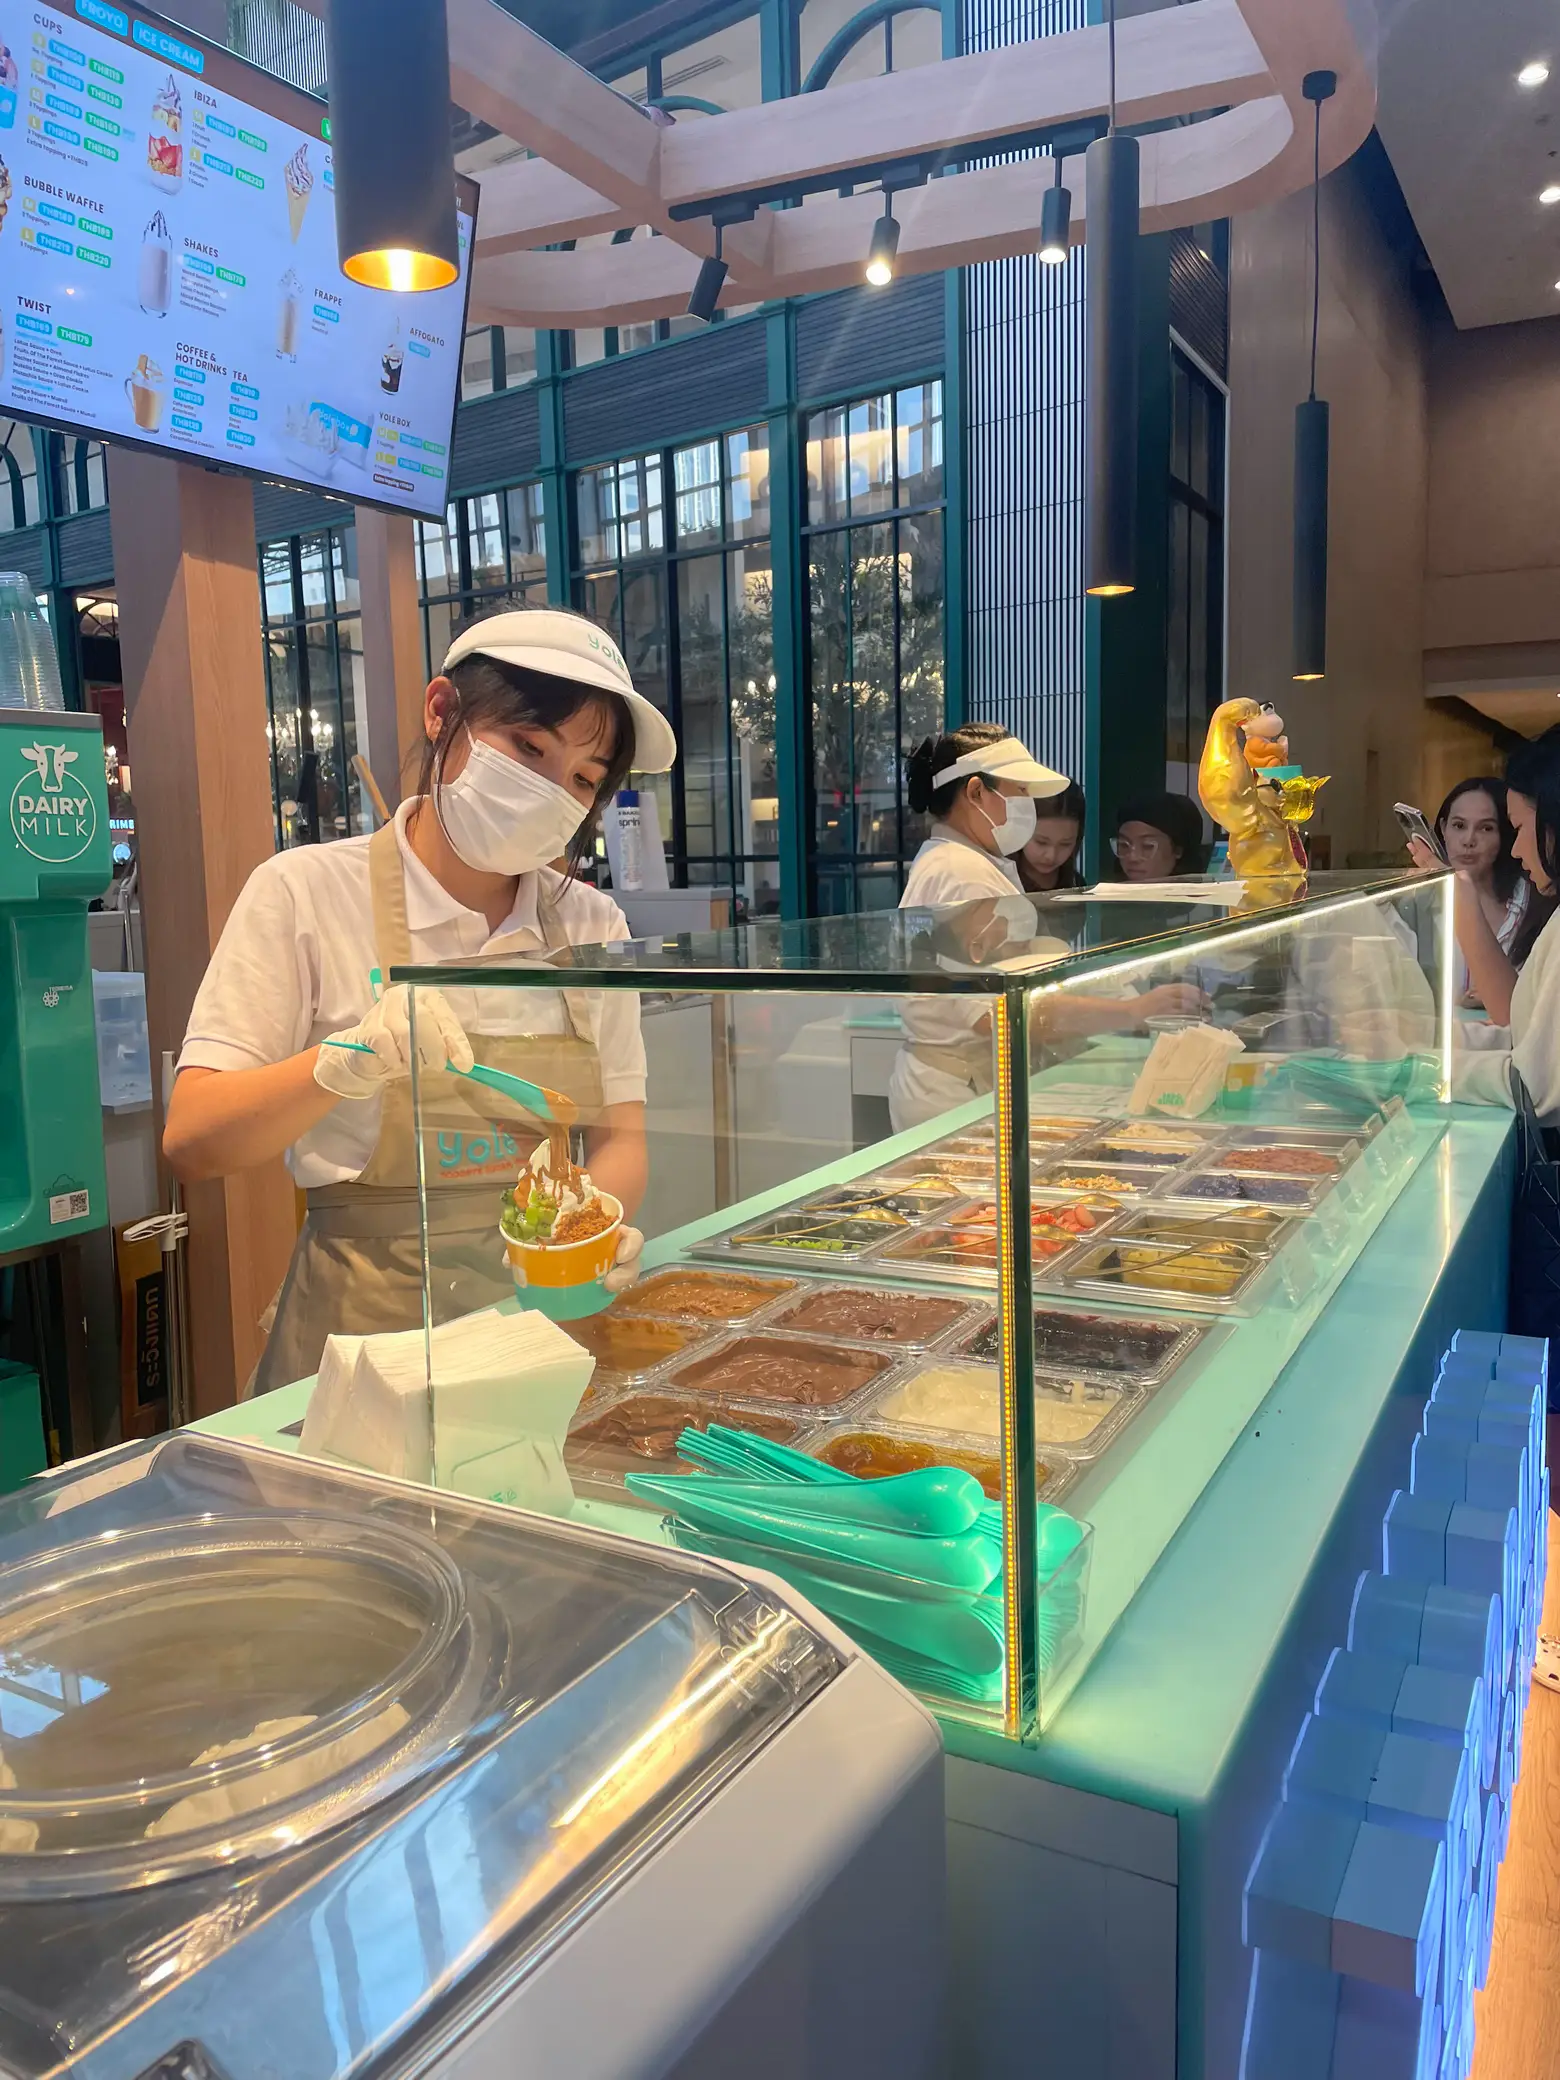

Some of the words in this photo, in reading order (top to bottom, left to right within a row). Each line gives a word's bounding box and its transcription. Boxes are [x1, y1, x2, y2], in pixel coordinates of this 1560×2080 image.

[33, 13, 63, 35] CUPS
[81, 0, 123, 28] FROYO
[139, 27, 157, 46] ICE
[160, 38, 200, 67] CREAM
[194, 89, 218, 109] IBIZA
[24, 175, 64, 199] BUBBLE
[65, 190, 105, 214] WAFFLE
[183, 237, 219, 258] SHAKES
[17, 296, 52, 314] TWIST
[314, 288, 342, 307] FRAPPE
[410, 327, 445, 347] AFFOGATO
[176, 342, 209, 360] COFFEE
[210, 352, 216, 362] &
[175, 352, 194, 365] HOT
[195, 359, 227, 376] DRINKS
[233, 370, 248, 382] TEA
[396, 417, 411, 428] BOX
[18, 795, 88, 817] DAIRY
[20, 817, 88, 837] MILK
